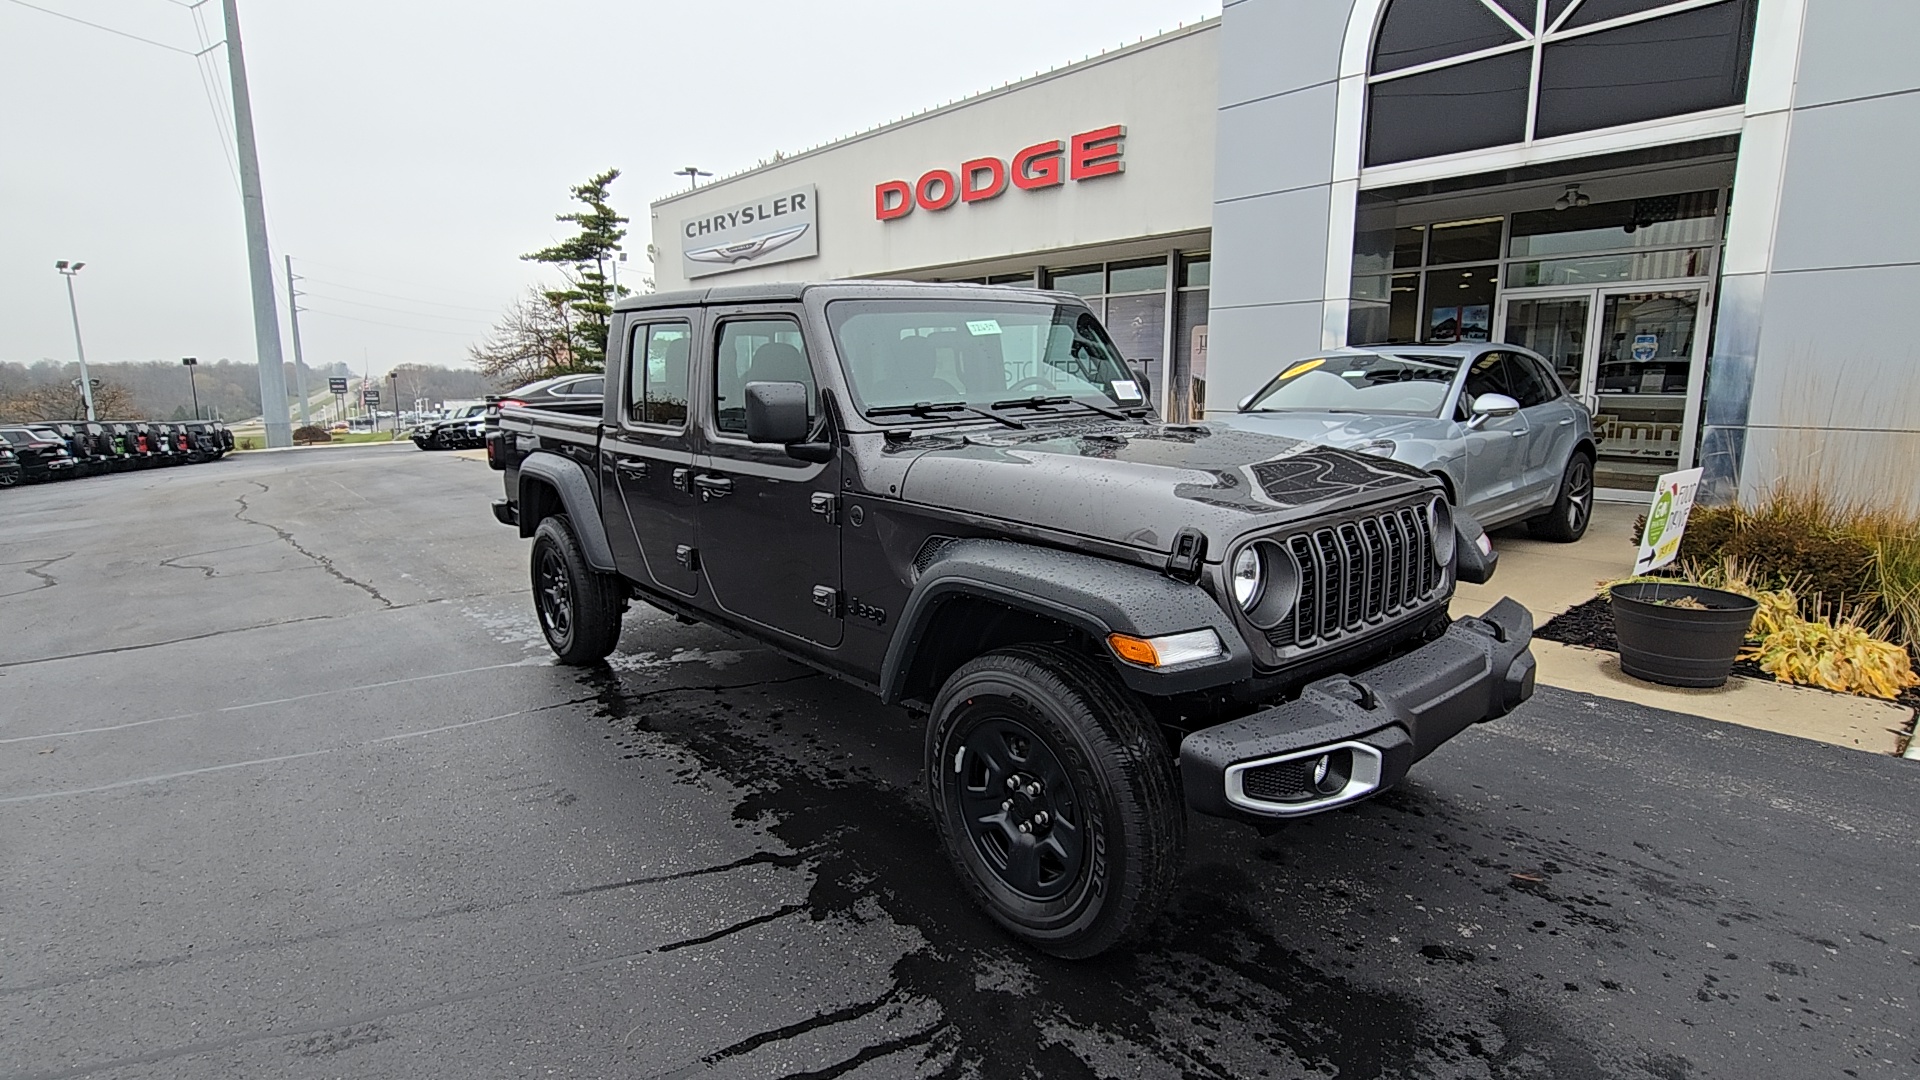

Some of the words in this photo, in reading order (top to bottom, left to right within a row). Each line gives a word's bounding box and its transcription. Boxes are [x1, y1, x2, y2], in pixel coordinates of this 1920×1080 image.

[875, 125, 1126, 220] DODGE
[685, 193, 806, 238] CHRYSLER
[847, 596, 887, 626] Jeep
[1008, 692, 1108, 899] BRIDGESTONE
